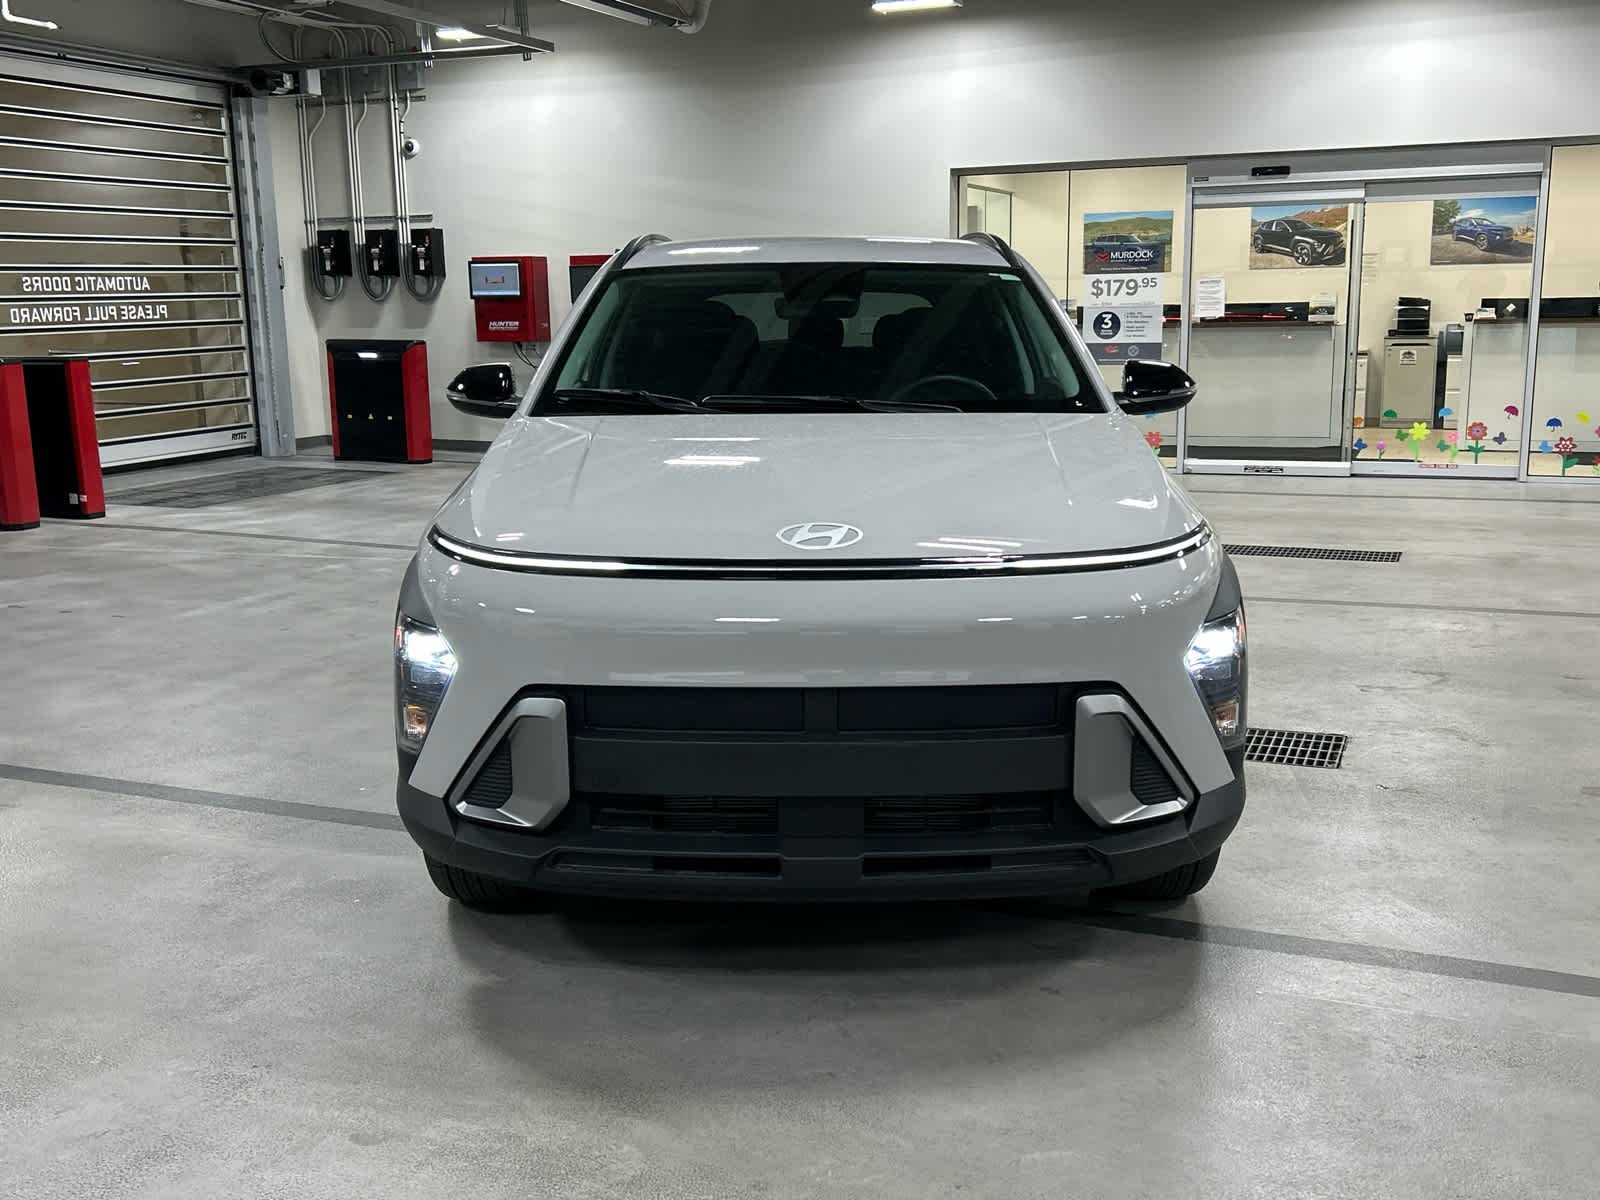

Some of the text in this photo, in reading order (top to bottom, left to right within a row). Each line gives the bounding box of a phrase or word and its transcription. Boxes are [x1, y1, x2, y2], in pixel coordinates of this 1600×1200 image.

[1110, 250, 1154, 259] MURDOCK
[1091, 277, 1158, 299] $179.95
[1101, 313, 1113, 329] 3
